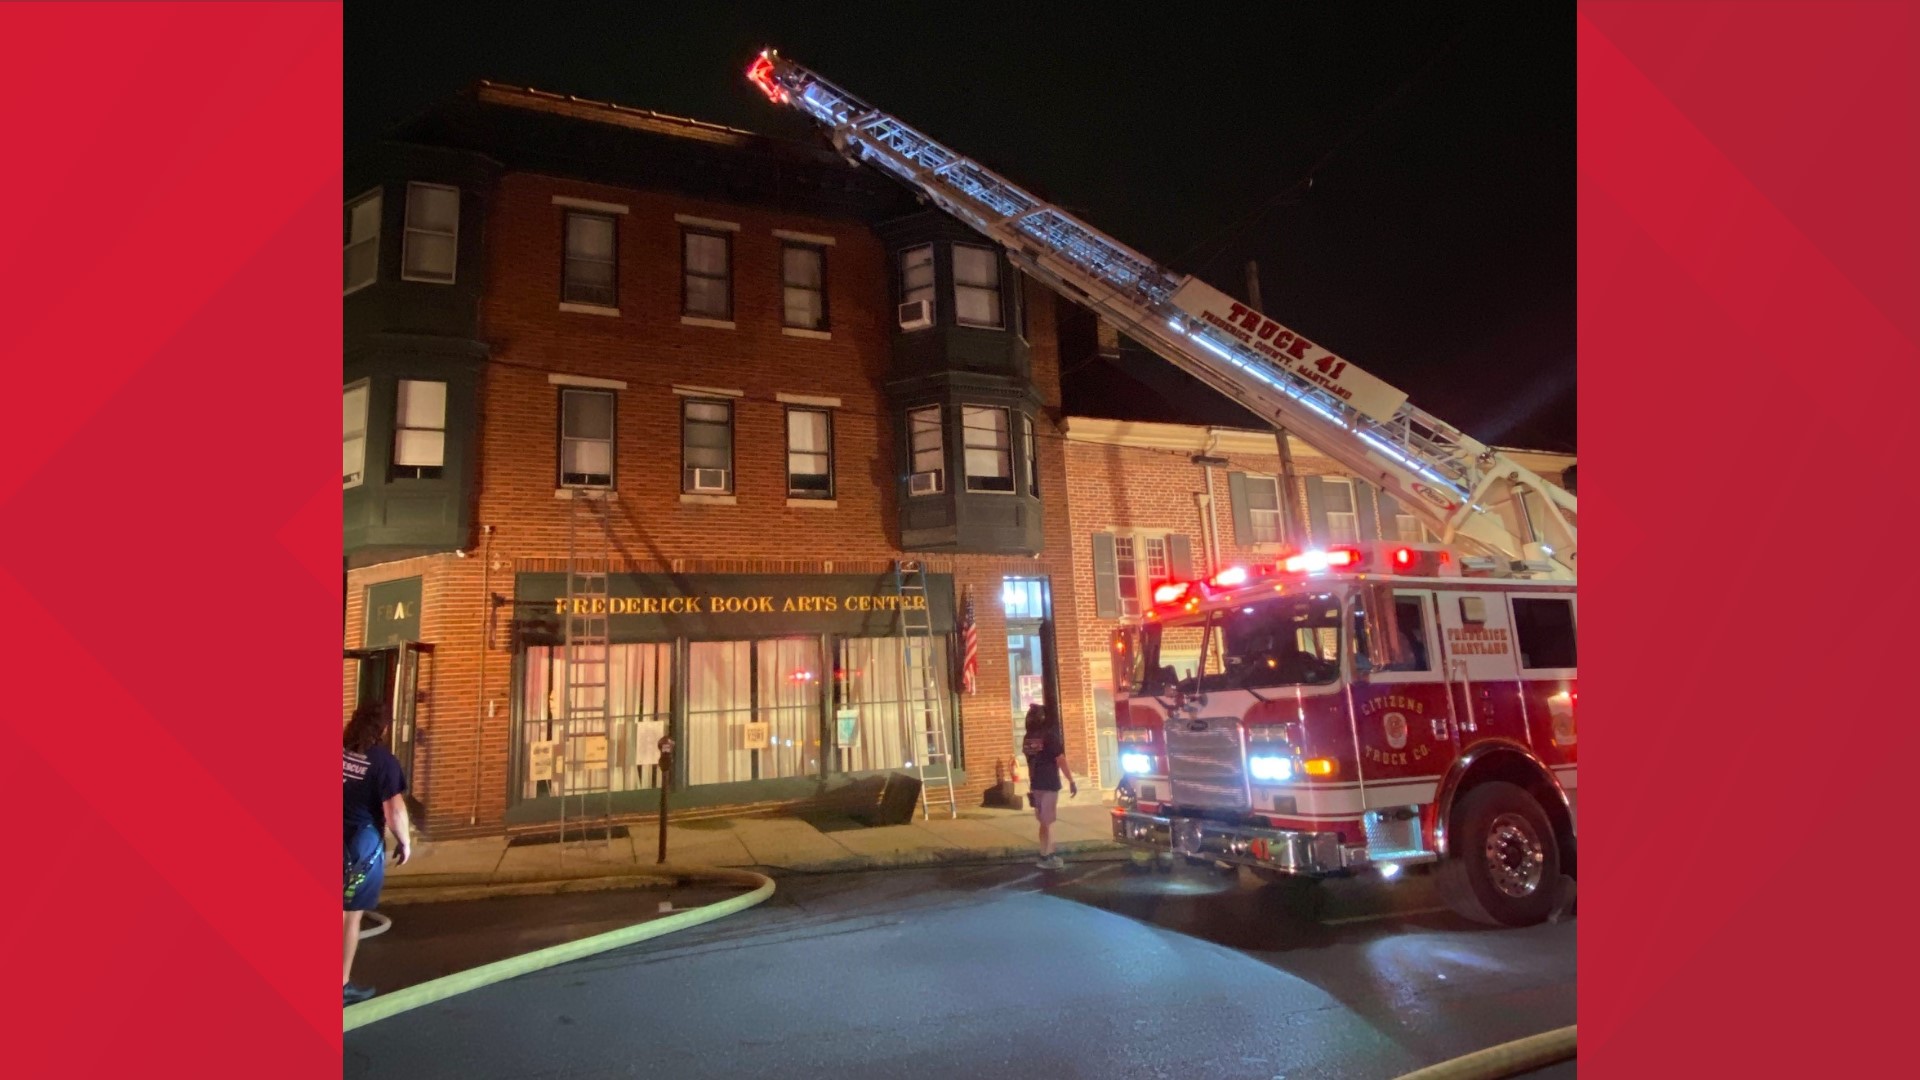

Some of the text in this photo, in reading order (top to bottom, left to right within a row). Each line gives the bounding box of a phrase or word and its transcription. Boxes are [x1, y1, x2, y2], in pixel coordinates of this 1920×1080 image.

[1228, 302, 1347, 380] TRUCK 41
[1201, 310, 1253, 343] FREDERICK
[1297, 365, 1353, 400] MARYLAND
[554, 596, 926, 615] FREDERICK BOOK ARTS CENTER
[1447, 628, 1508, 640] FREDERICK
[1451, 642, 1508, 655] MARYLAND
[1361, 695, 1423, 715] CITIZENS
[1365, 745, 1407, 765] TRUCK
